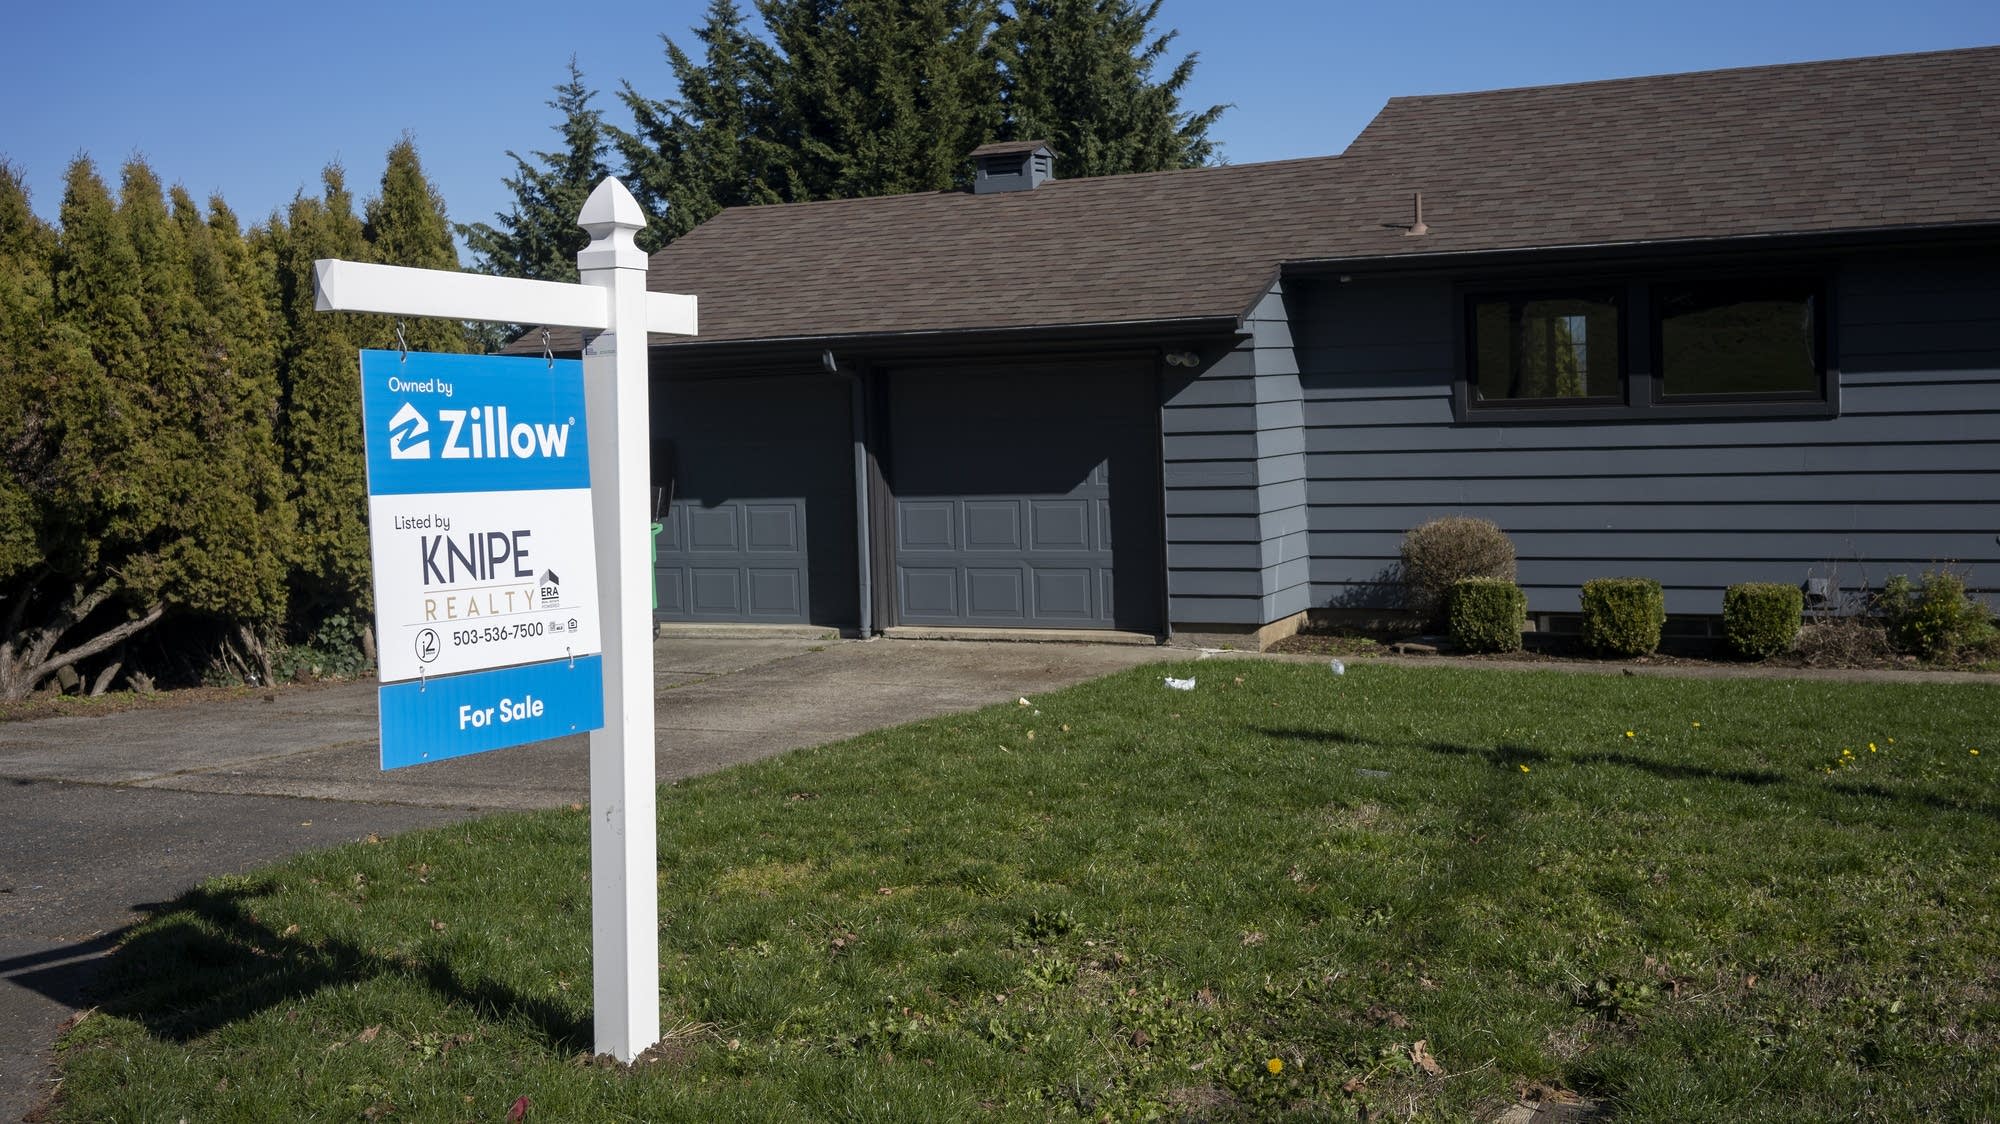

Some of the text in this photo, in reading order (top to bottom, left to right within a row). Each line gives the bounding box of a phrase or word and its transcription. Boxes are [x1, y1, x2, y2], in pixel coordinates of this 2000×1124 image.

[388, 377, 453, 397] Owned by
[395, 514, 450, 531] Listed by
[421, 529, 534, 586] KNIPE
[425, 589, 535, 621] REALTY
[541, 587, 559, 597] ERA
[453, 621, 544, 647] 503-536-7500
[459, 695, 544, 730] For Sale
